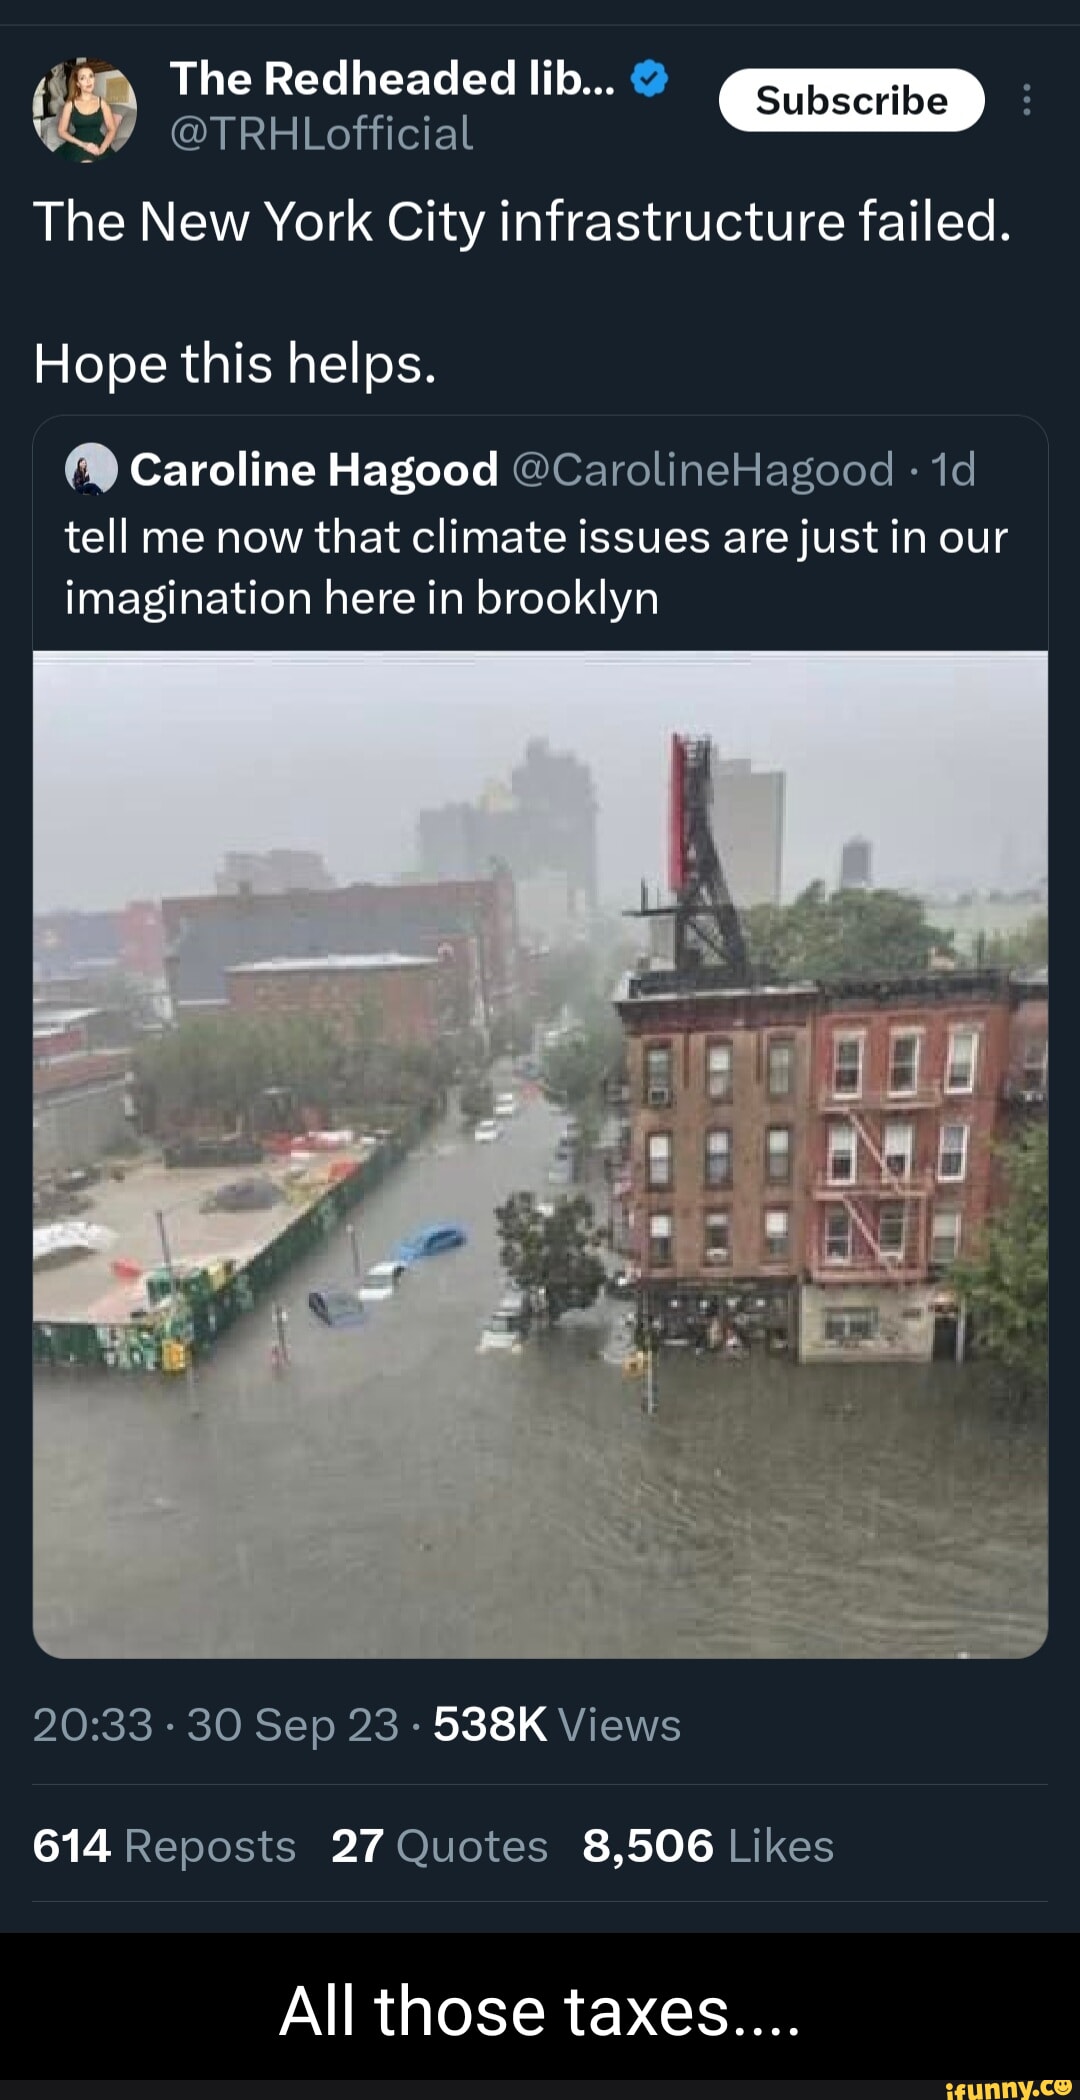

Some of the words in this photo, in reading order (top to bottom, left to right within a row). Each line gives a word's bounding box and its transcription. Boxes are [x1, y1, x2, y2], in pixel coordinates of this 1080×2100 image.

[170, 59, 252, 95] The
[266, 59, 515, 95] Redheaded
[531, 59, 614, 95] lib...
[756, 84, 948, 115] Subscribe
[172, 114, 473, 151] @TRHLofficial
[33, 198, 124, 241] The
[142, 201, 250, 241] New
[264, 198, 373, 241] York
[389, 199, 486, 252] City
[501, 198, 844, 241] infrastructure
[859, 198, 1009, 241] failed.
[36, 343, 166, 394] Hope
[181, 340, 272, 383] this
[290, 340, 434, 394] helps.
[131, 450, 315, 486] Caroline
[330, 450, 497, 495] Hagood
[514, 450, 892, 495] @CarolineHagood
[932, 451, 974, 486] 1d
[64, 517, 126, 553] tell
[143, 528, 204, 553] me
[218, 528, 303, 553] now
[314, 517, 400, 553] that
[413, 517, 566, 553] climate
[580, 518, 709, 553] issues
[724, 528, 788, 553] are
[797, 518, 878, 562] just
[892, 518, 925, 553] in
[940, 528, 1008, 553] our
[67, 579, 310, 623] imagination
[326, 578, 415, 614] here
[429, 579, 462, 614] in
[478, 578, 657, 623] brooklyn
[34, 1708, 152, 1741] 20:33
[188, 1708, 241, 1741] 30
[256, 1708, 335, 1750] Sep
[349, 1708, 398, 1741] 23
[434, 1706, 548, 1741] 538K
[558, 1707, 680, 1741] Views
[34, 1829, 111, 1862] 614
[127, 1829, 295, 1871] Reposts
[332, 1829, 384, 1862] 27
[398, 1829, 547, 1868] Quotes
[583, 1829, 713, 1869] 8,506
[731, 1827, 833, 1862] Likes
